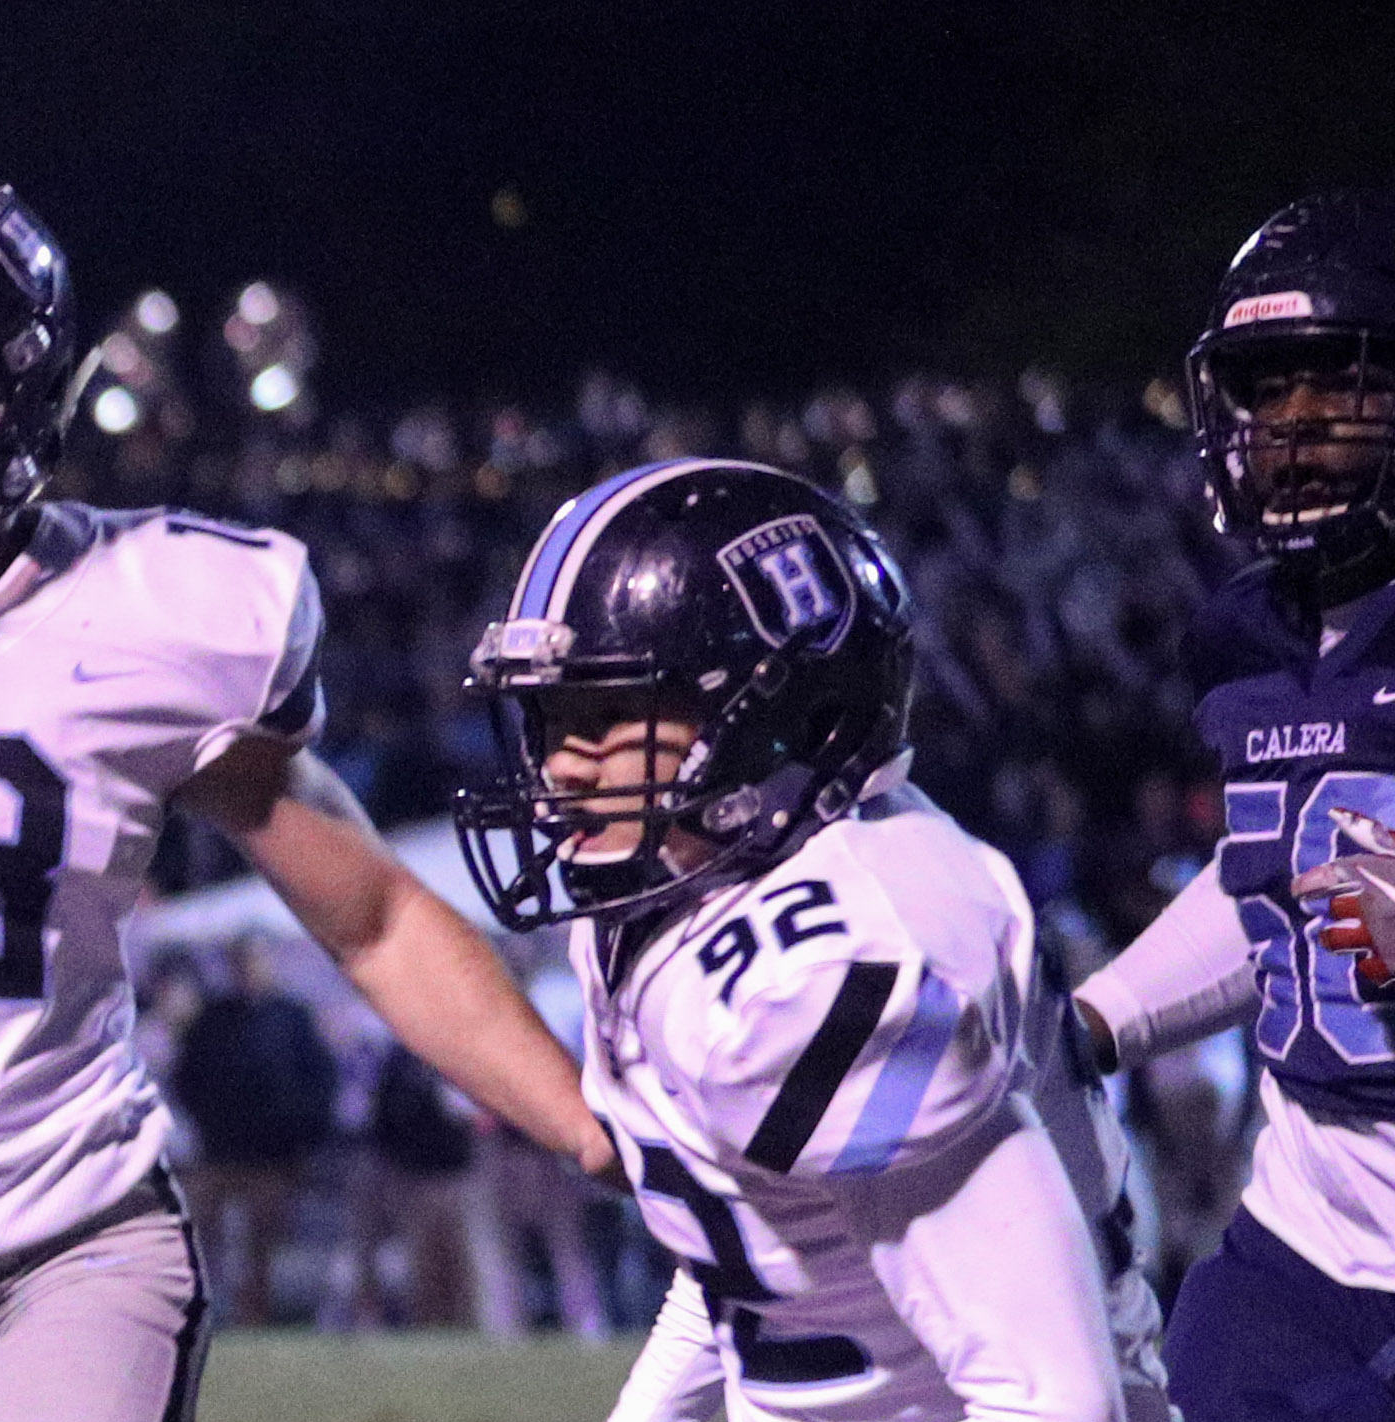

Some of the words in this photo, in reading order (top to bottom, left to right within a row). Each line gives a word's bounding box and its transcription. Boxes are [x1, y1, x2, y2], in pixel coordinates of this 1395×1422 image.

[757, 542, 835, 629] H
[1246, 721, 1345, 763] CALERA
[695, 878, 849, 1009] 92
